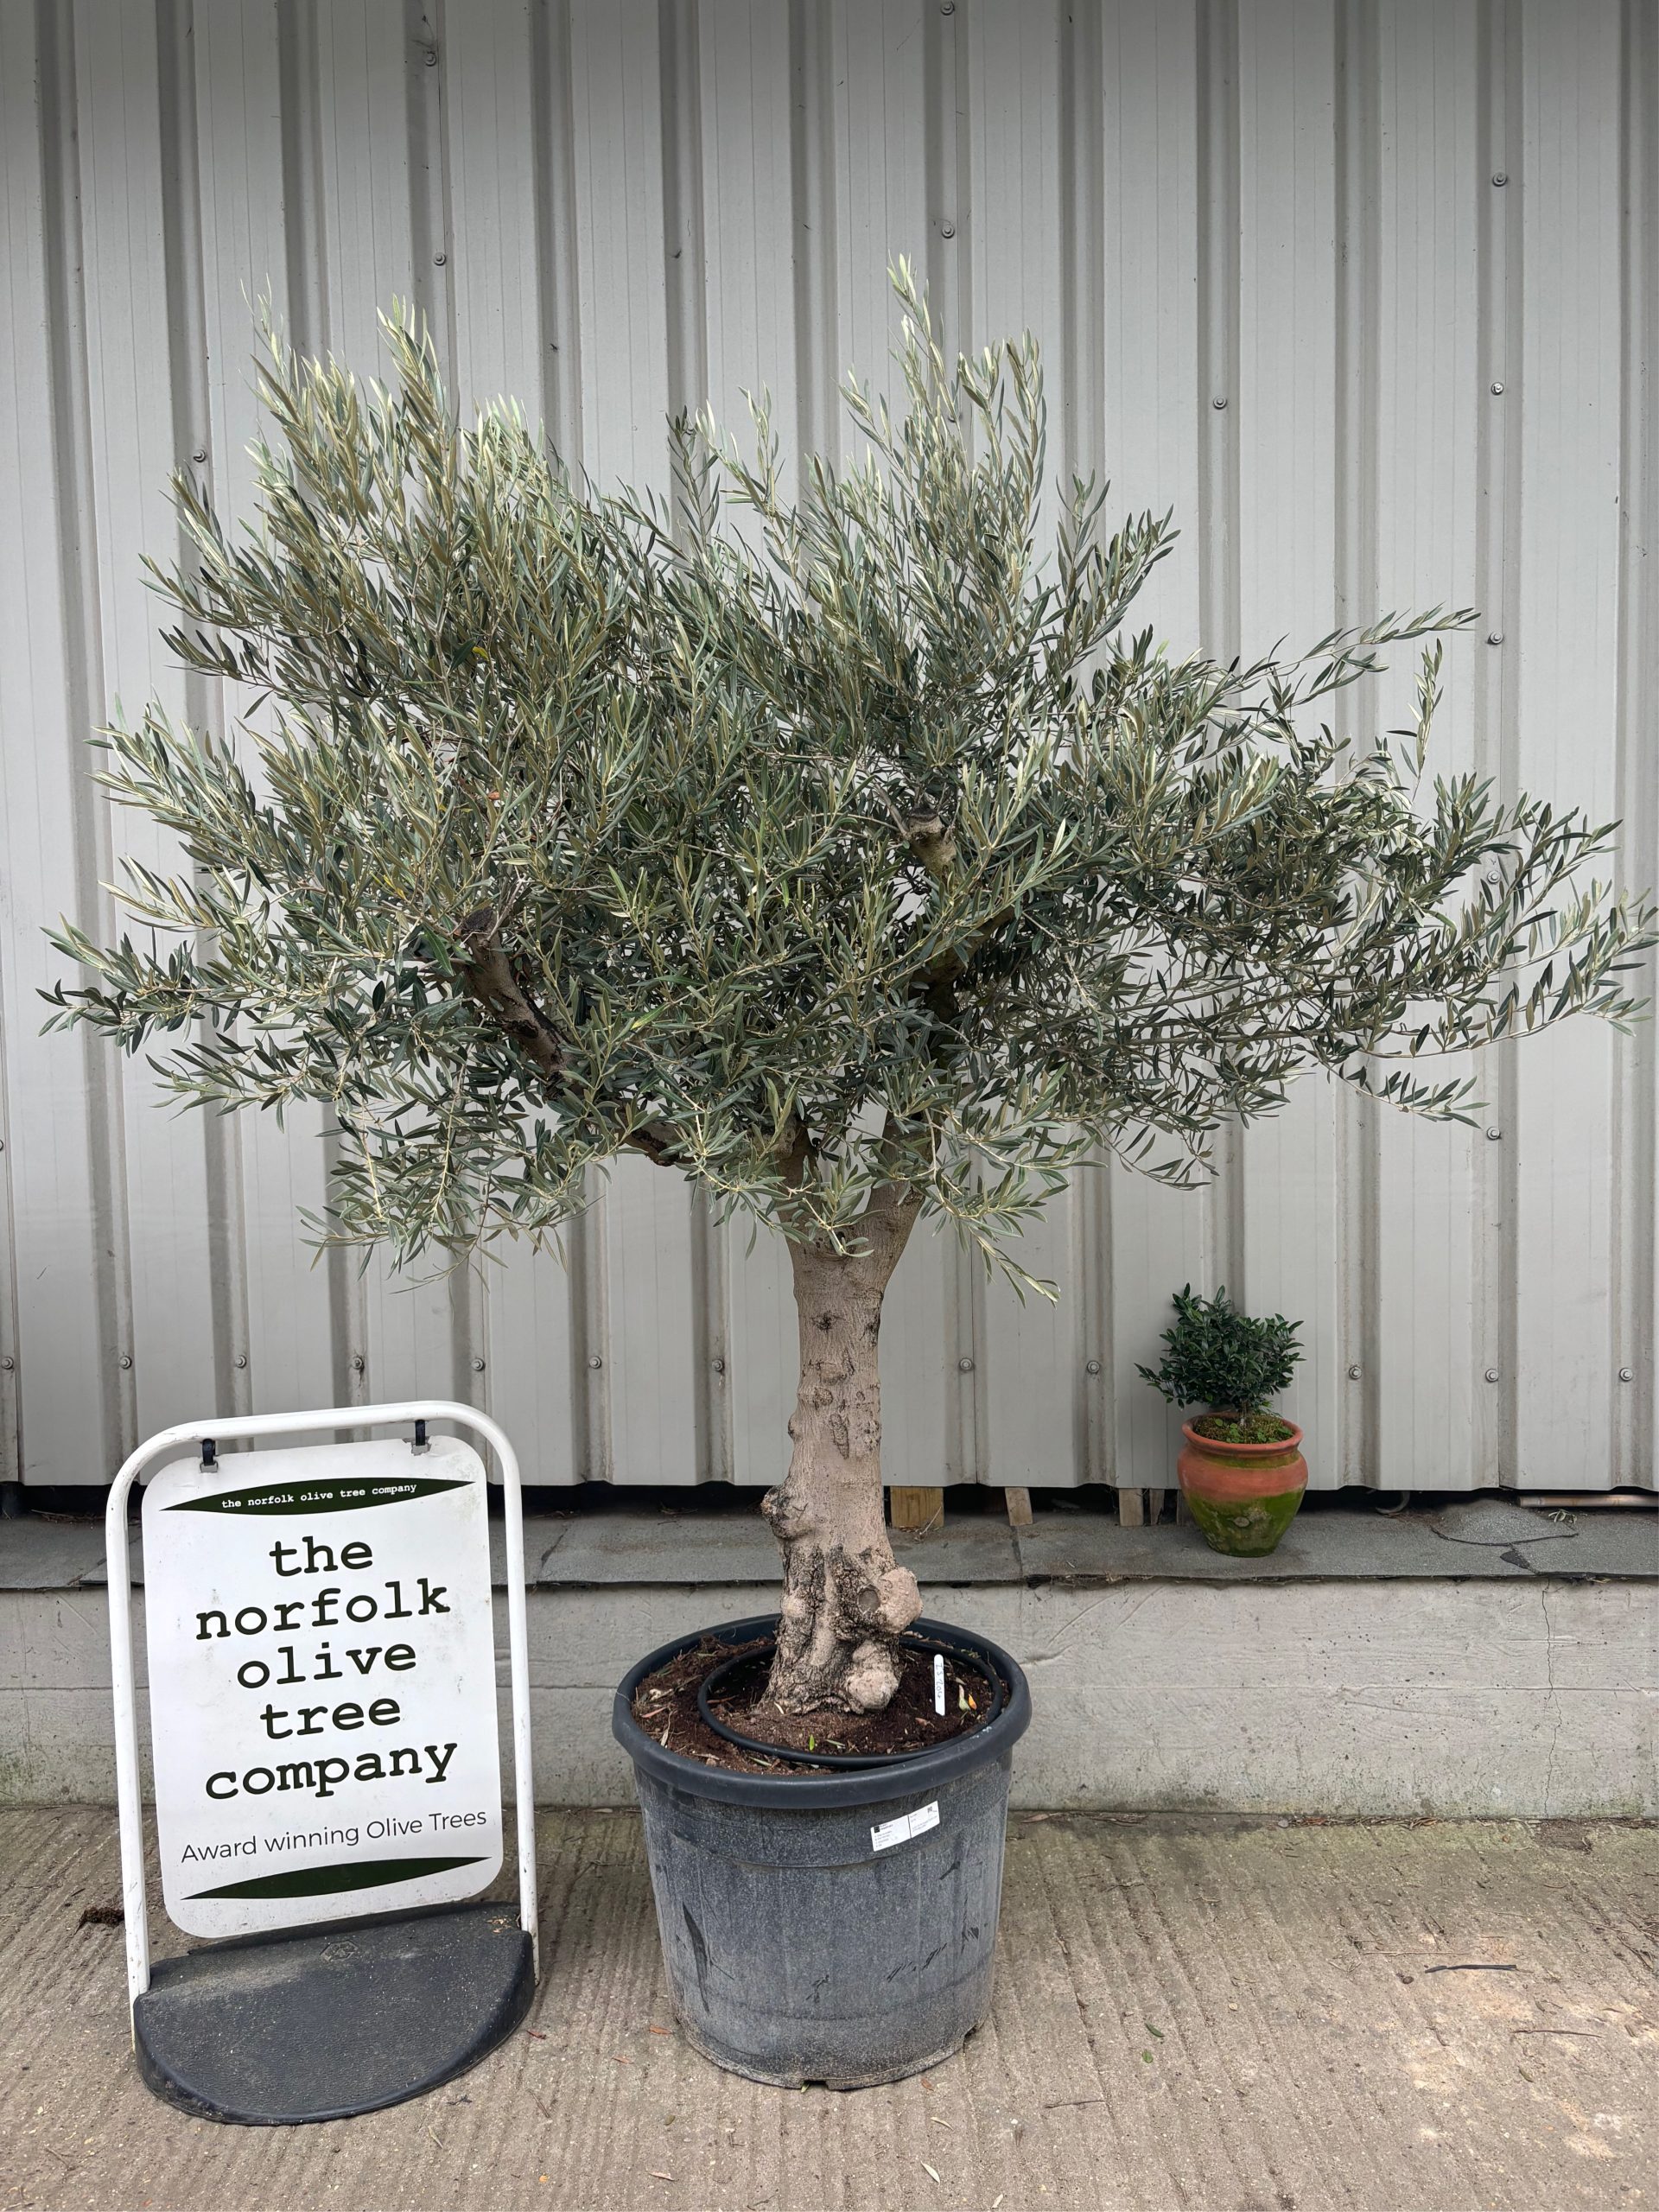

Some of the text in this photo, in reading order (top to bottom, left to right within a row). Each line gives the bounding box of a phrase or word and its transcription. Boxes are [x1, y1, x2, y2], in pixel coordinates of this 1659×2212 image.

[221, 1484, 417, 1509] the norfolk olive tree company
[270, 1535, 373, 1577] the
[195, 1577, 451, 1640] norfolk
[237, 1640, 416, 1689] olive
[259, 1698, 401, 1739] tree
[206, 1742, 458, 1800] company
[181, 1811, 486, 1864] Award winning Olive Trees
